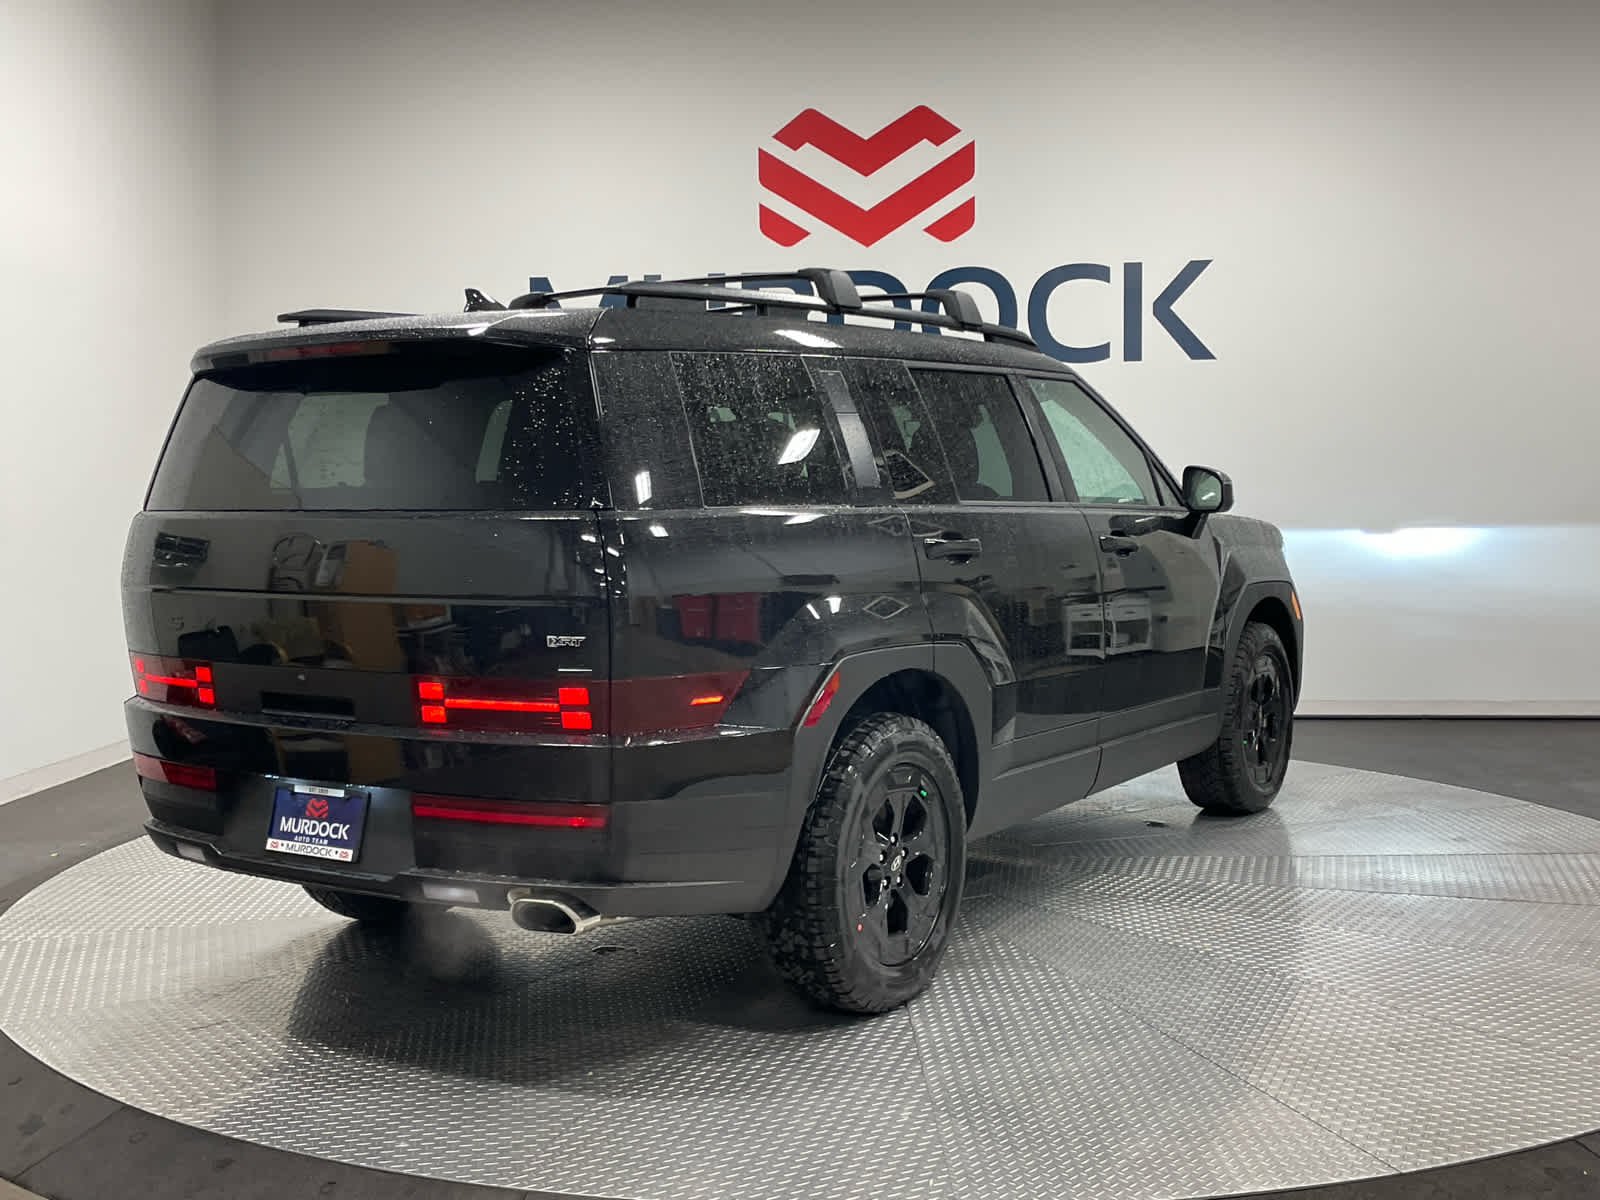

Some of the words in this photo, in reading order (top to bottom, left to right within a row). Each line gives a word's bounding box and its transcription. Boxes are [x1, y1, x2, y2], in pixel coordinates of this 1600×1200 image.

[529, 259, 1217, 363] DOCK
[280, 816, 350, 840] MURDOCK
[294, 835, 311, 843] AUTO
[312, 837, 329, 845] TEAM
[285, 844, 332, 857] MURDOCK
